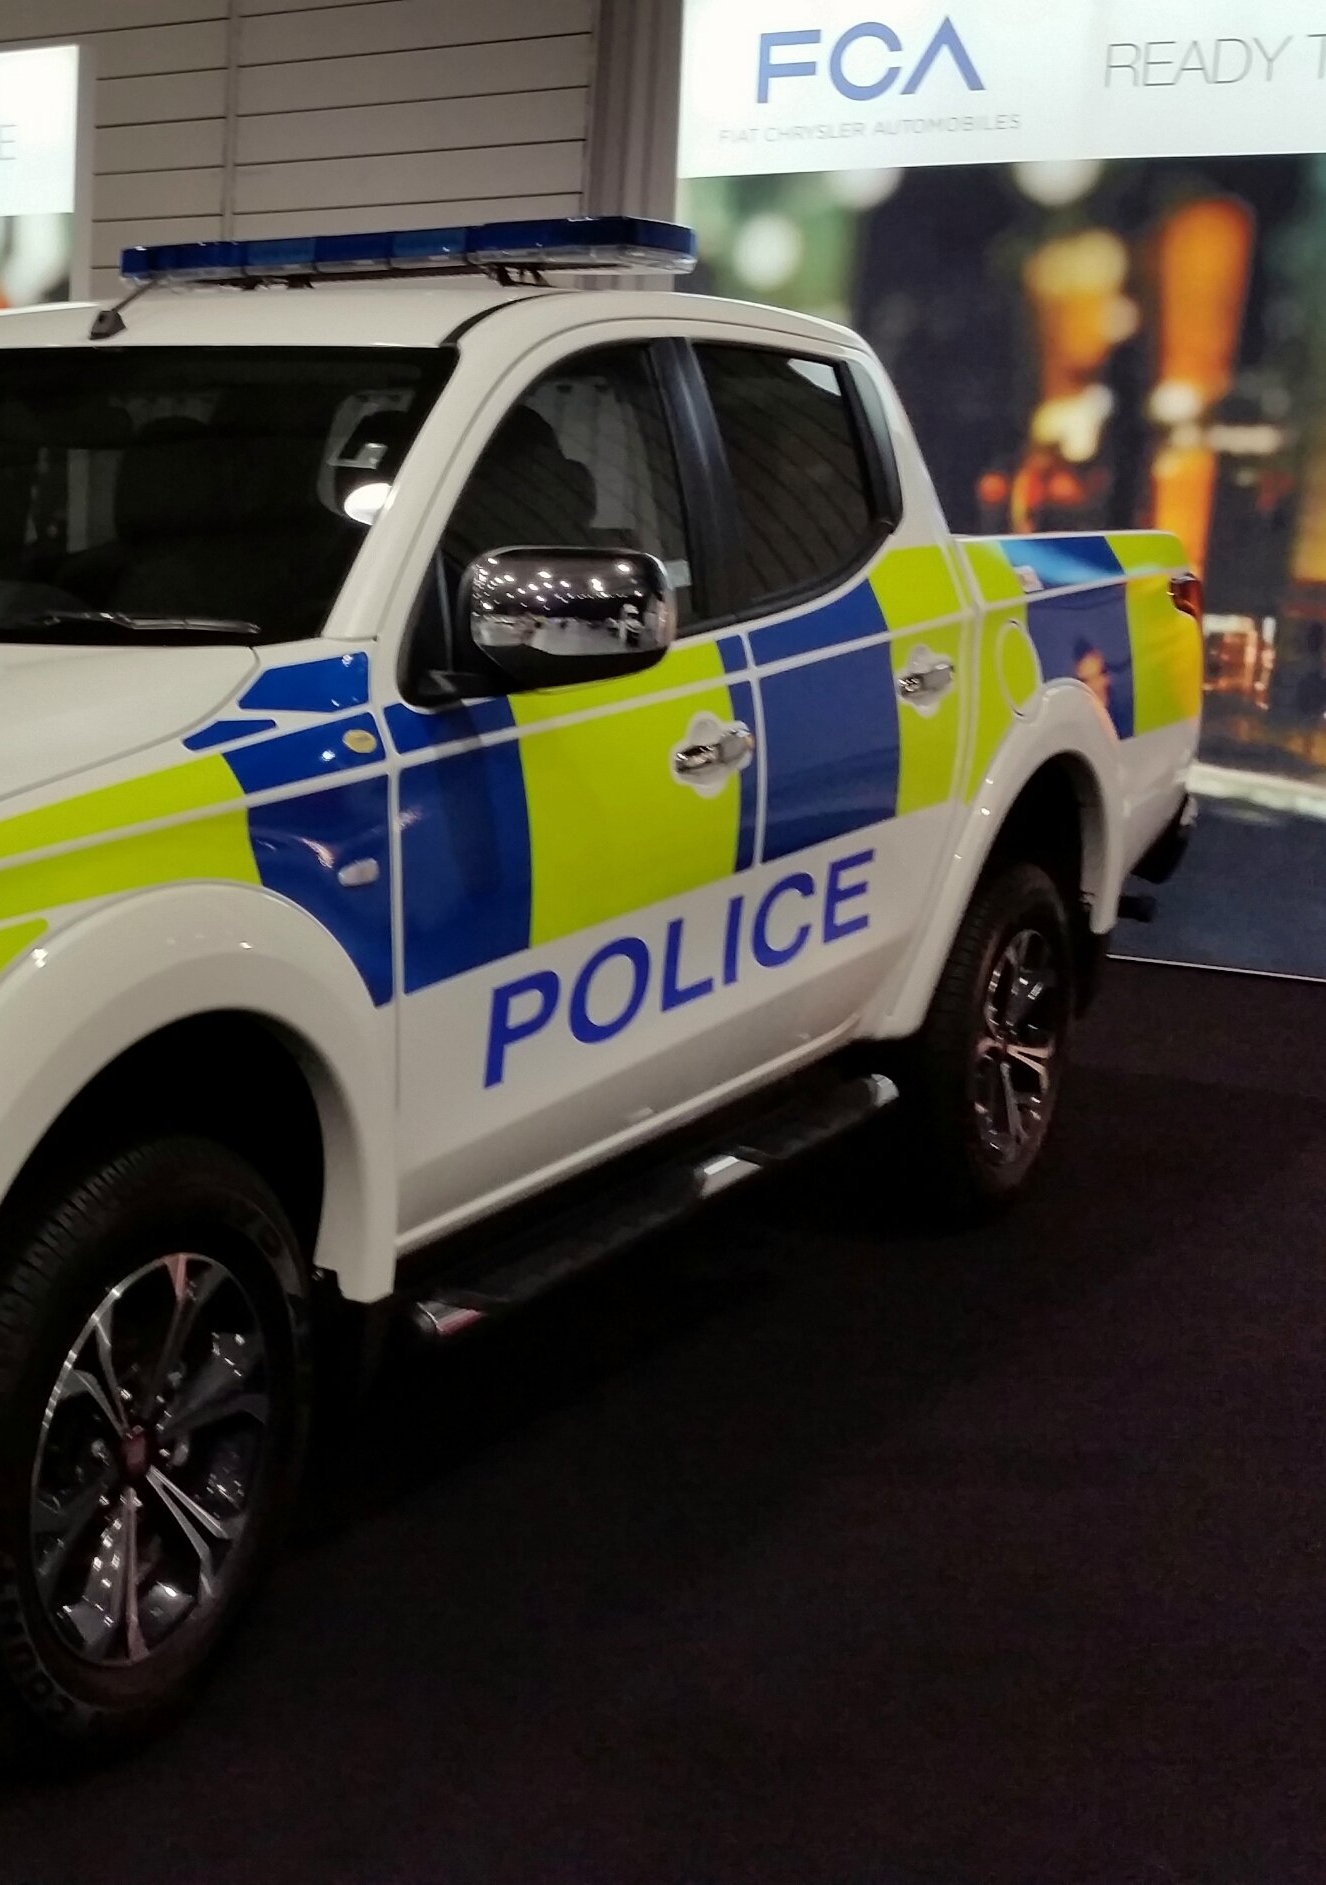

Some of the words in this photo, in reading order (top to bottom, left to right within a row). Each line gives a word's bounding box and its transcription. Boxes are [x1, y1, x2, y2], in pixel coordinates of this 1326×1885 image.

[757, 16, 985, 104] FCA
[1104, 34, 1294, 88] READY
[1306, 33, 1326, 80] T
[719, 128, 760, 144] FIAT
[766, 121, 867, 143] CHRYSLER
[873, 113, 1022, 136] AUTOMOBILES
[483, 848, 878, 1089] POLICE
